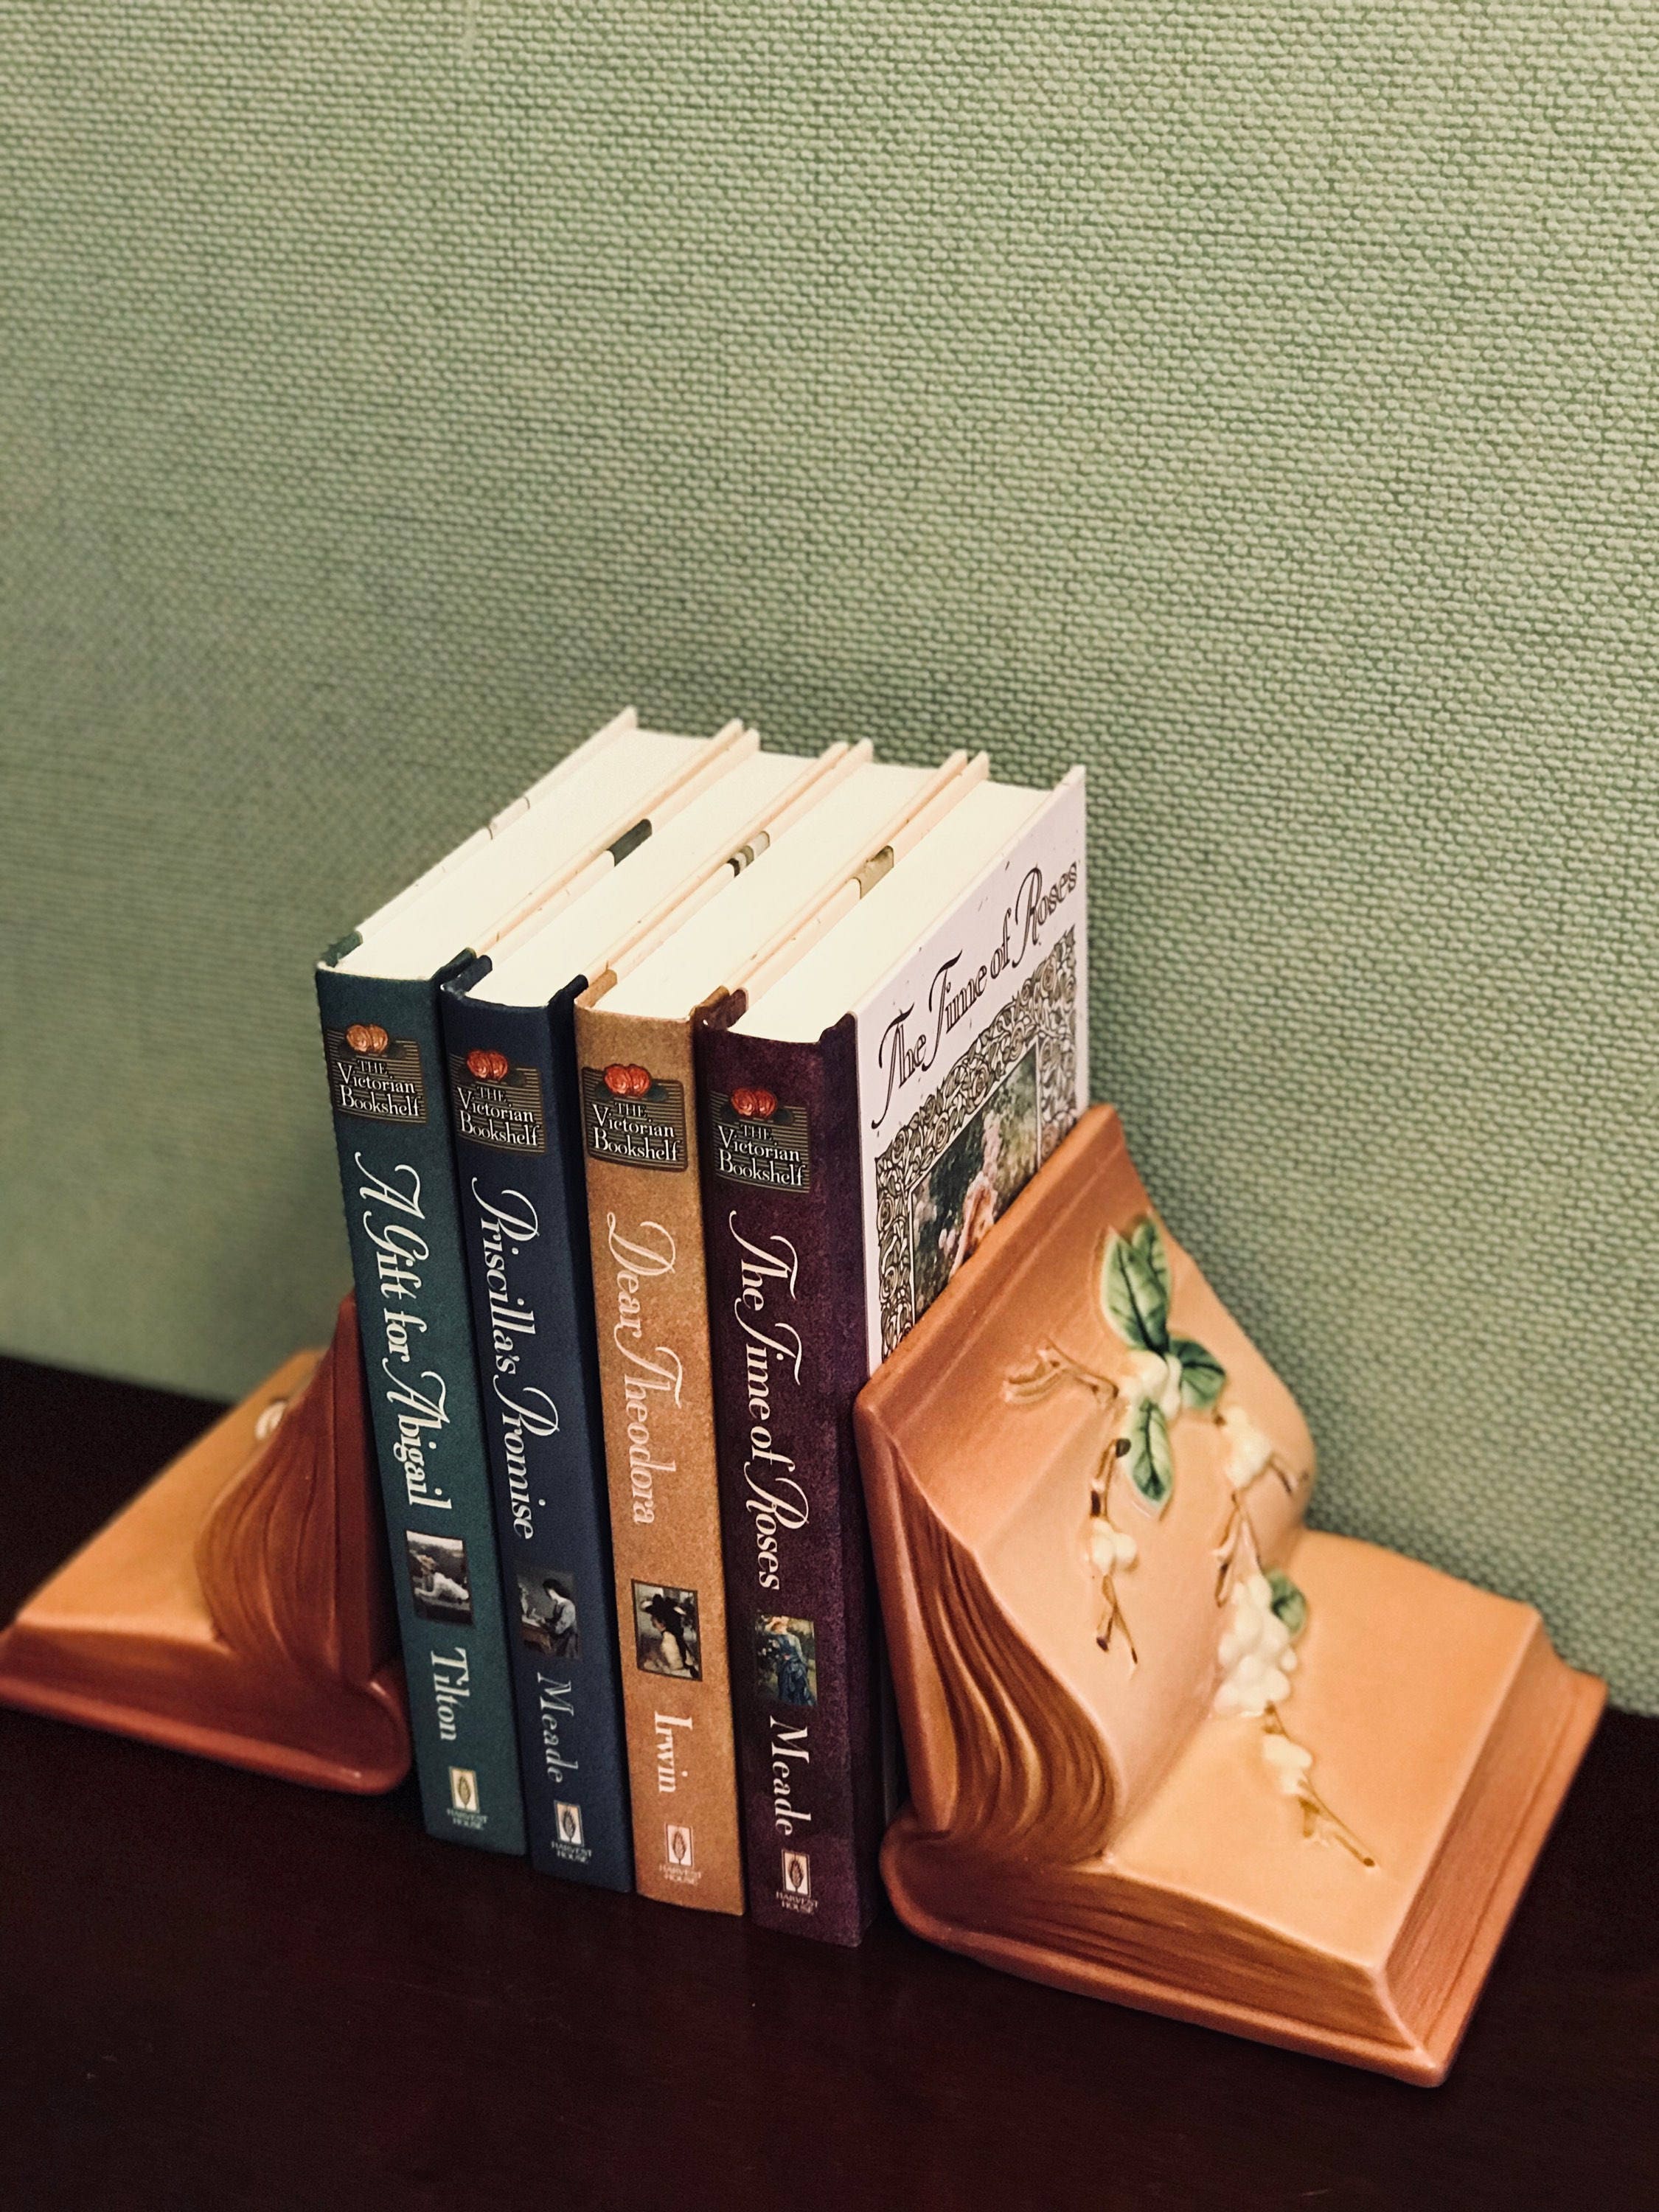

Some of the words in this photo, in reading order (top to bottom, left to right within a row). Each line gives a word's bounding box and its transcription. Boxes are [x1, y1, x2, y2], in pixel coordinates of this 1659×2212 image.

[872, 1003, 927, 1129] The
[922, 950, 987, 1071] Time
[990, 908, 1012, 979] of
[1012, 863, 1077, 968] Roses
[337, 1062, 416, 1093] Victorian
[340, 1085, 421, 1116] Bookshelf
[358, 1060, 388, 1075] THE
[477, 1086, 507, 1103] THE
[457, 1087, 534, 1122] Victorian
[459, 1110, 540, 1146] Bookshelf
[592, 1104, 675, 1138] Victorian
[613, 1102, 647, 1118] THE
[740, 1124, 773, 1141] THE
[594, 1127, 681, 1161] Bookshelf
[718, 1125, 800, 1162] Victorian
[719, 1149, 806, 1186] Bookshelf
[355, 1152, 425, 1219] A
[364, 1211, 429, 1299] Gift
[471, 1178, 540, 1375] Priscilla's
[606, 1211, 676, 1338] Dear
[728, 1211, 798, 1311] The
[383, 1307, 427, 1363] for
[734, 1298, 801, 1420] Time
[382, 1358, 452, 1509] Abigail
[493, 1374, 560, 1540] Promise
[613, 1323, 683, 1525] Theodora
[750, 1426, 796, 1472] of
[744, 1461, 810, 1590] Roses
[431, 1647, 470, 1741] Tilton
[538, 1672, 578, 1783] Meade
[654, 1711, 693, 1793] Irwin
[770, 1716, 811, 1835] Meade
